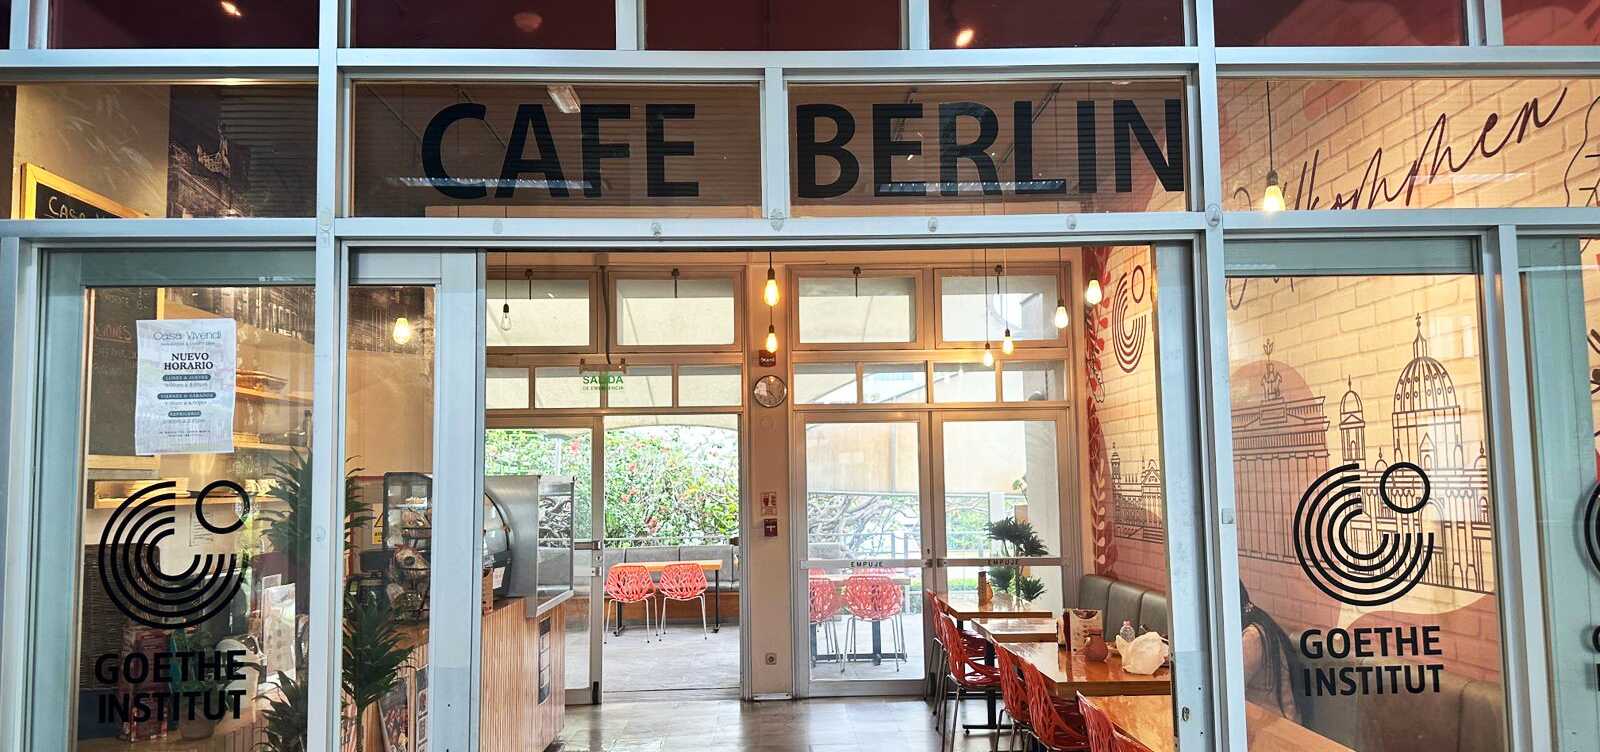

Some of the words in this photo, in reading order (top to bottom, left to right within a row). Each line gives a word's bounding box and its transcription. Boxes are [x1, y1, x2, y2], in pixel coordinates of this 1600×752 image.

[421, 102, 699, 199] CAFE
[796, 99, 1185, 198] BERLIN
[164, 361, 214, 370] HORARIO
[171, 352, 209, 361] NUEVO
[582, 375, 624, 384] SADA
[1299, 625, 1443, 660] GOETHE
[94, 649, 247, 685] GOETHE
[1303, 664, 1445, 697] INSTITUT
[98, 689, 247, 724] INSTITUT
